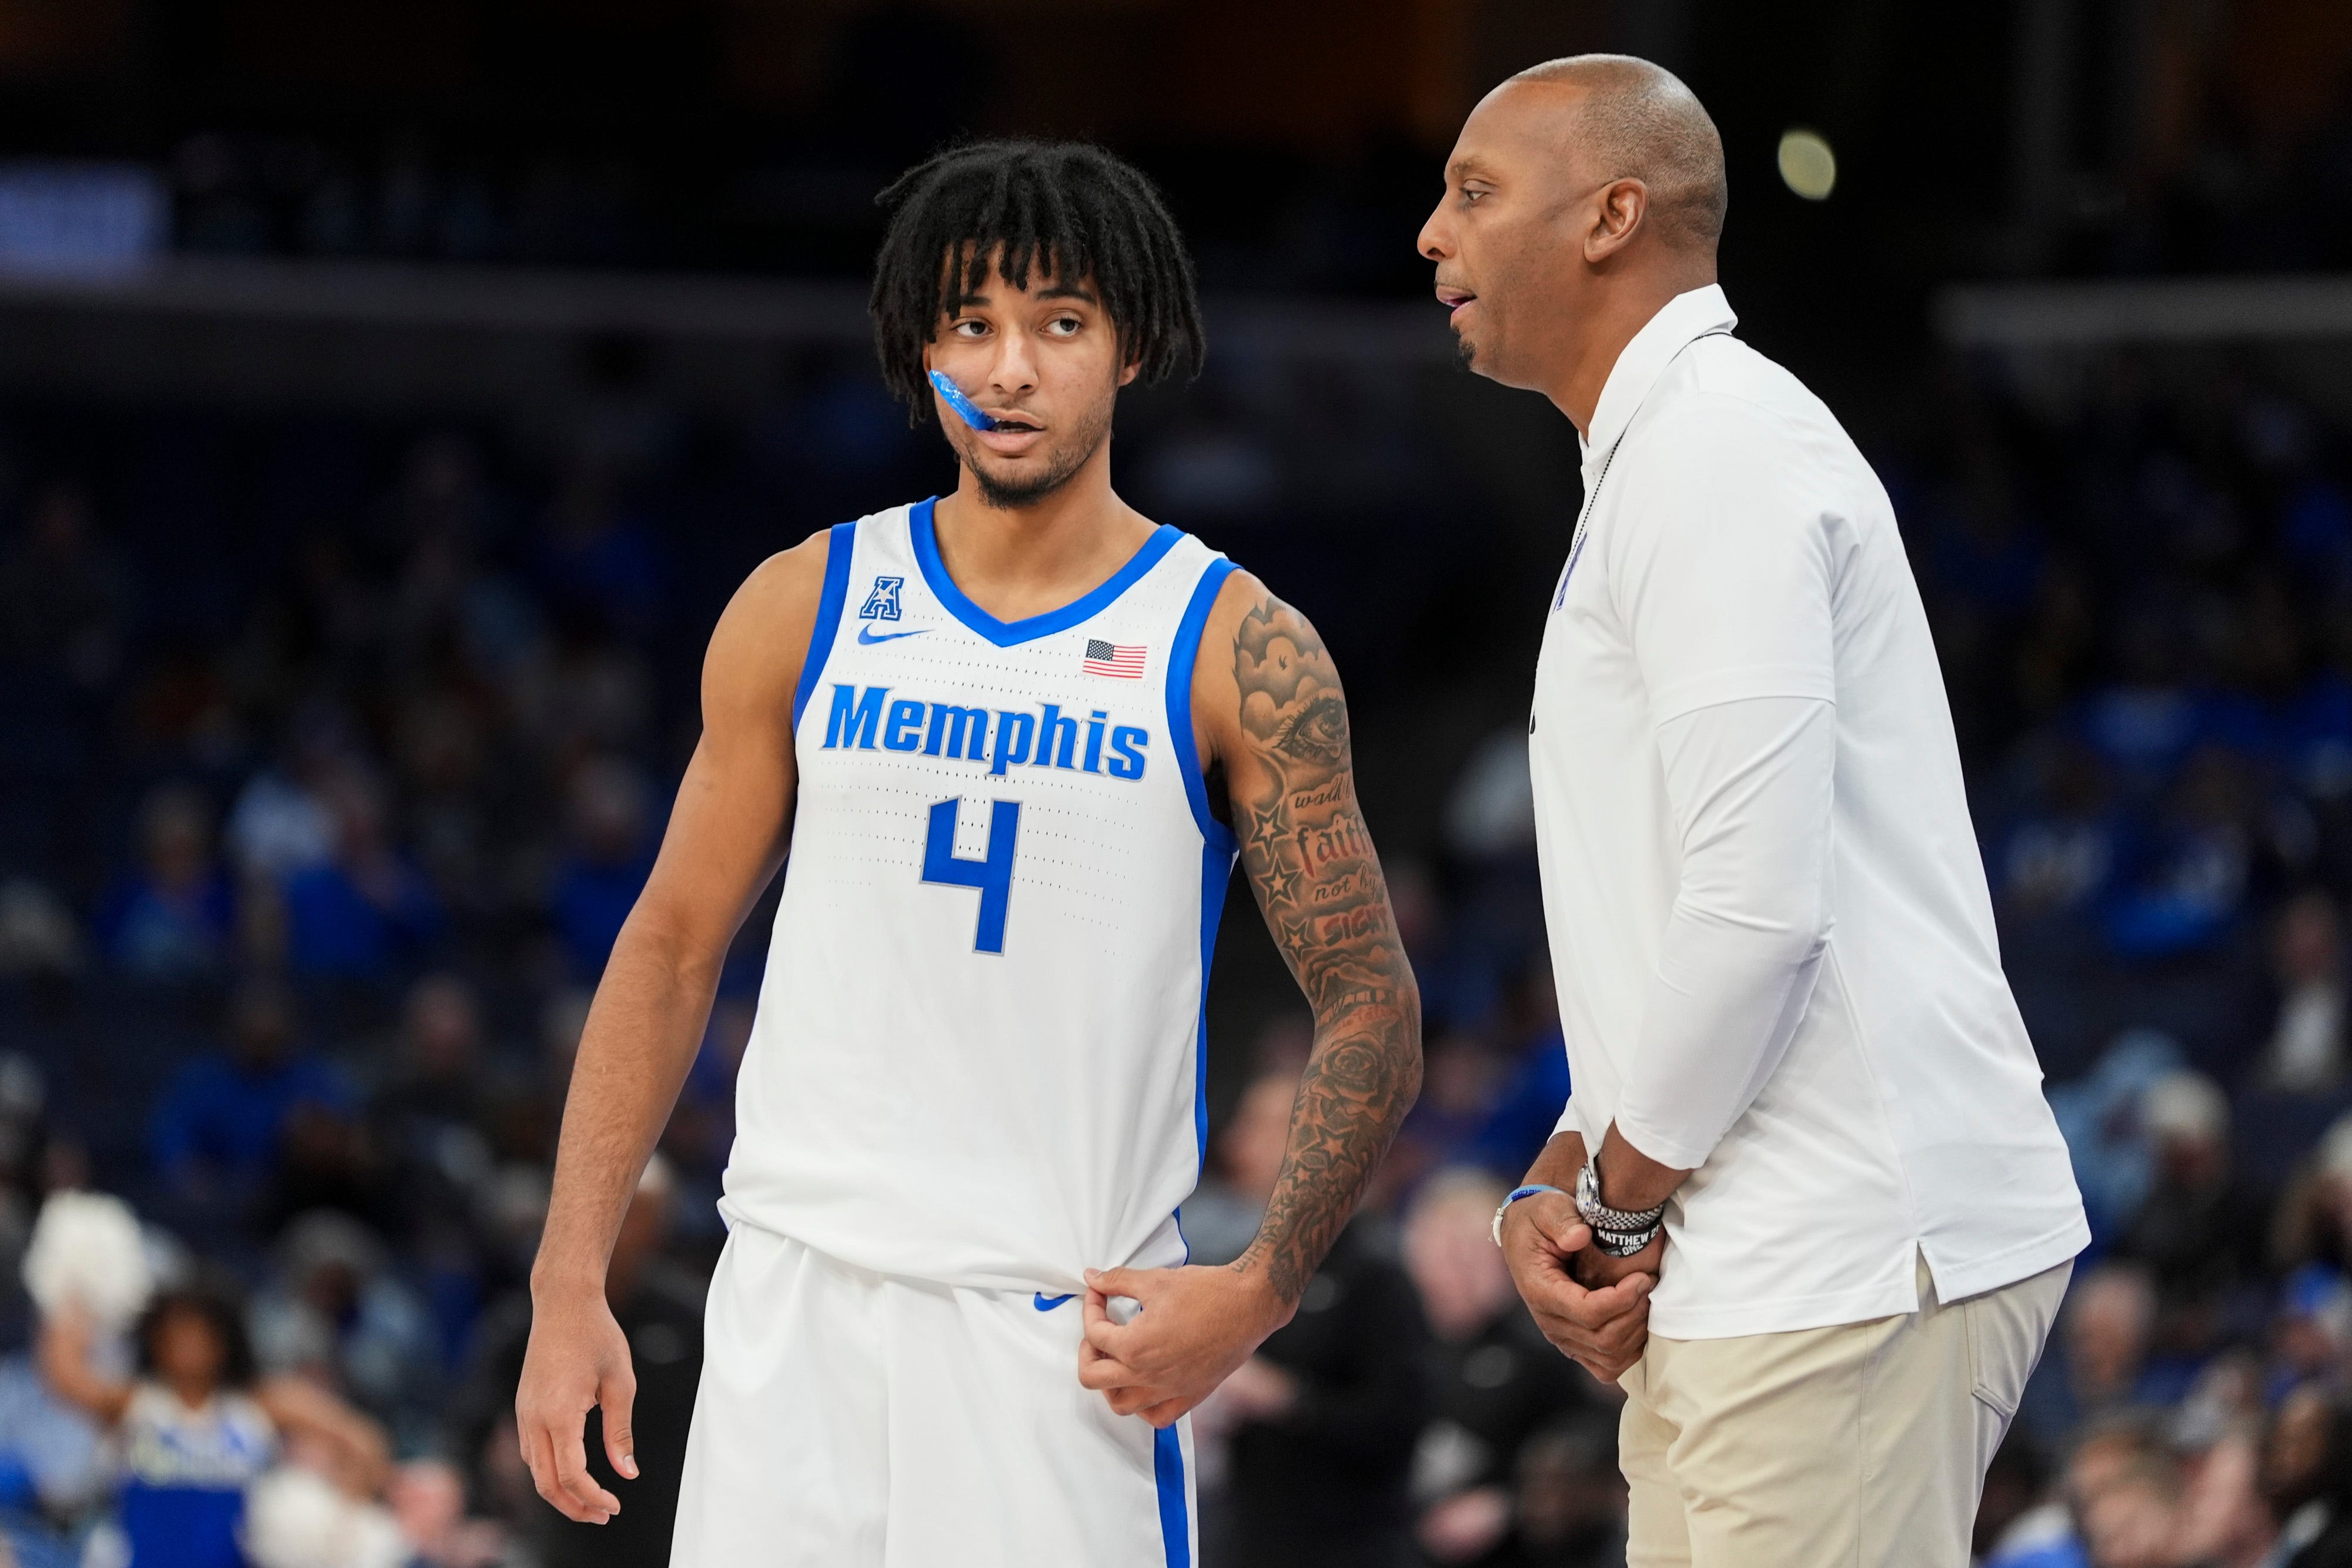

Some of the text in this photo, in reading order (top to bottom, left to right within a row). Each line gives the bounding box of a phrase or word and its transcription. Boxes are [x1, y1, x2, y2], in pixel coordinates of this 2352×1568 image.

[819, 683, 1150, 783] Memphis
[1297, 816, 1373, 878] faith
[919, 794, 1023, 957] 4
[1315, 865, 1377, 901] not by
[1324, 907, 1389, 947] SIGHT
[1598, 1229, 1649, 1246] MATTHEW
[1622, 1243, 1643, 1256] ONE
